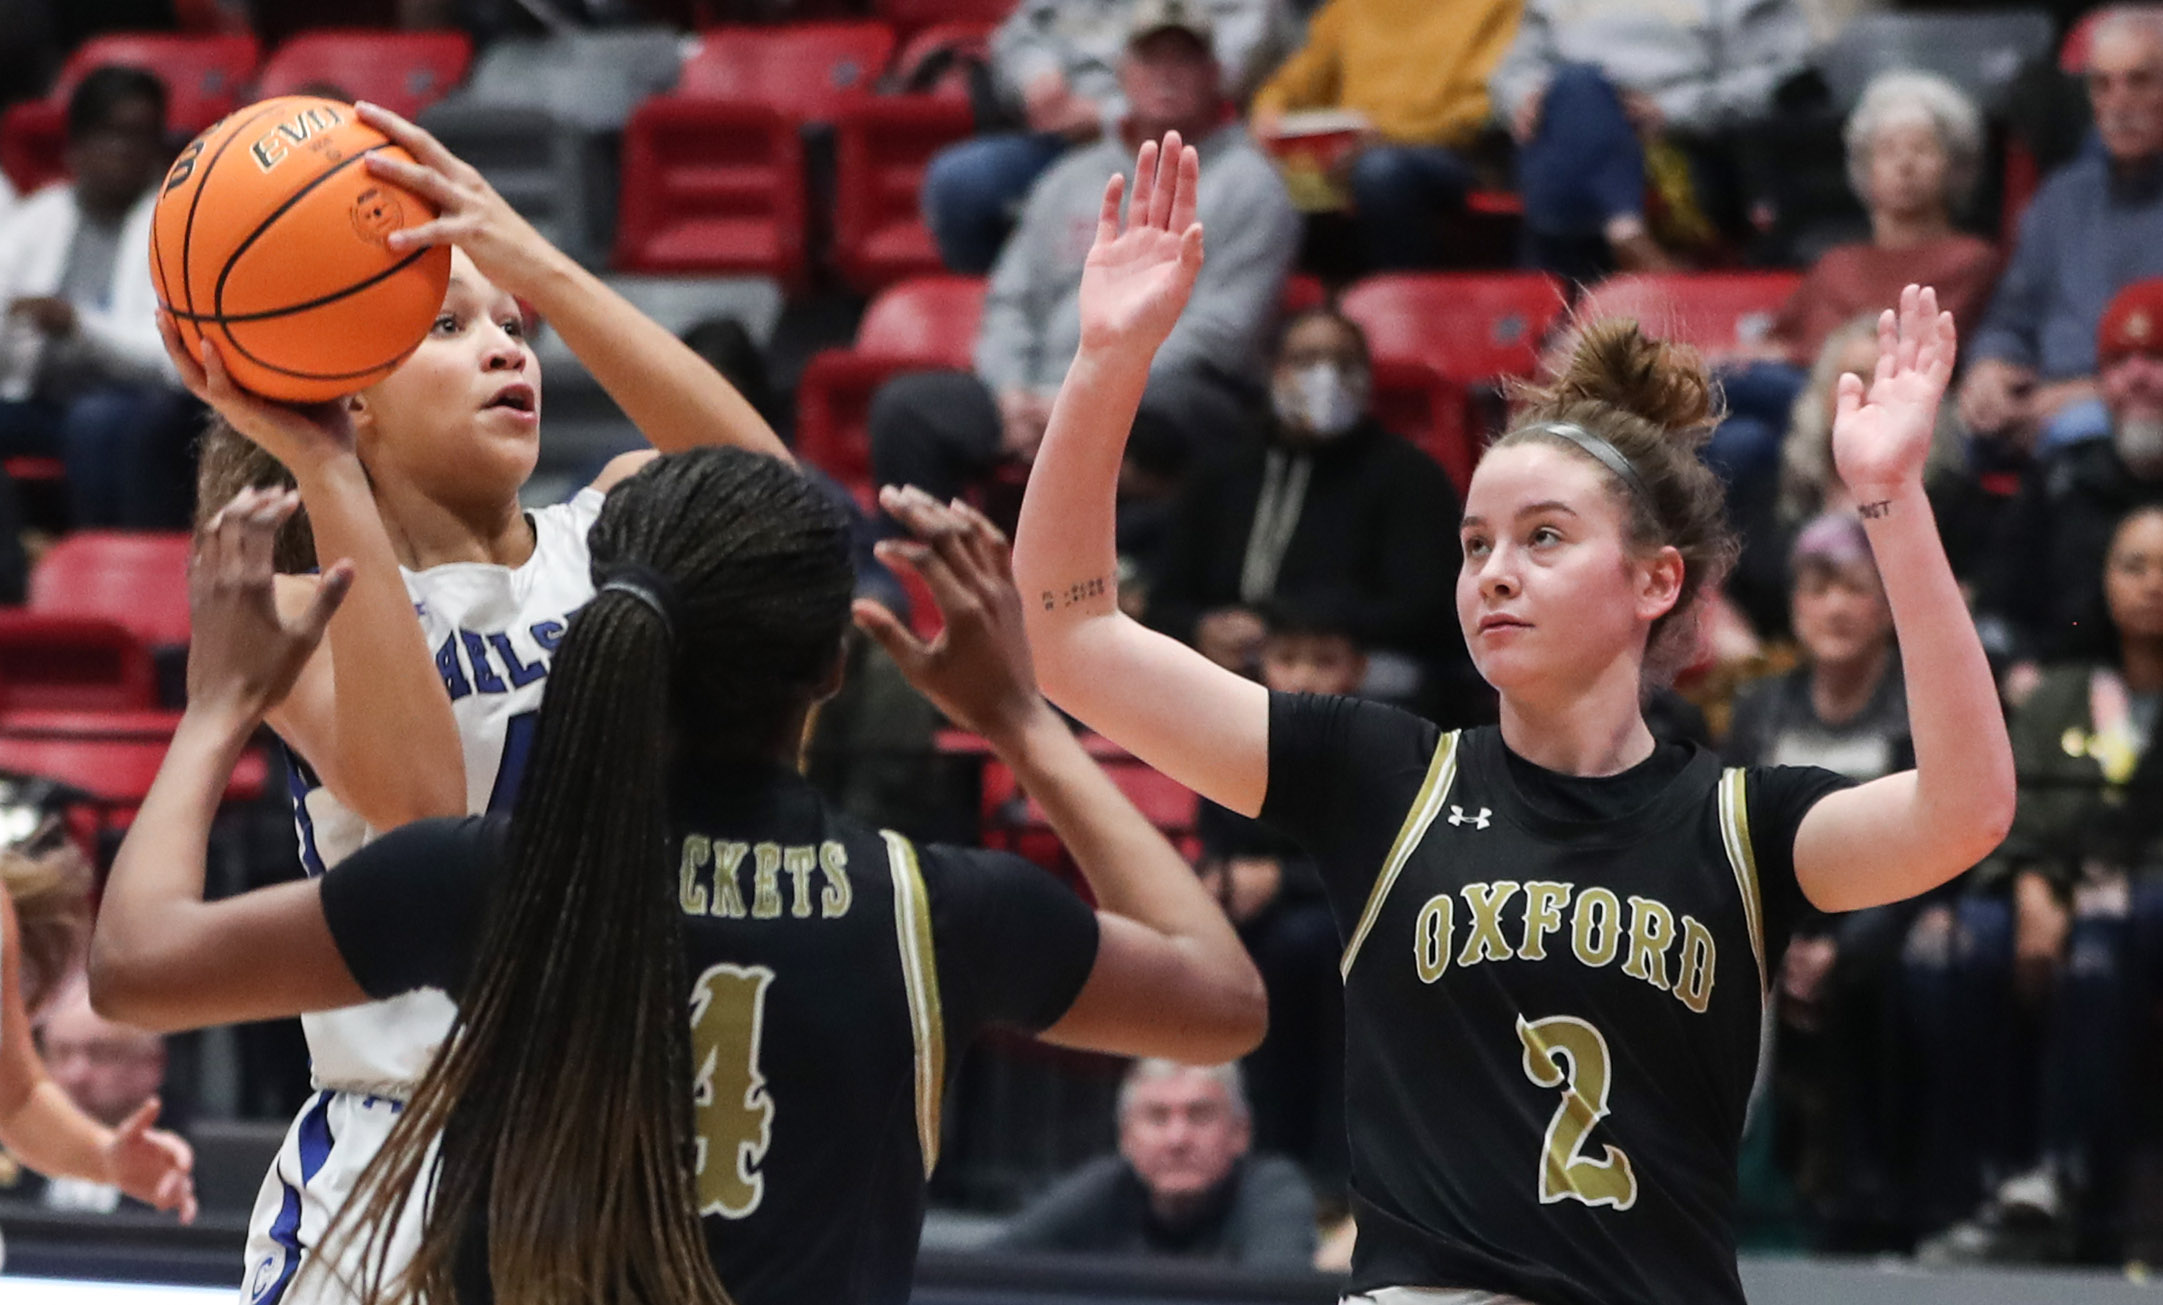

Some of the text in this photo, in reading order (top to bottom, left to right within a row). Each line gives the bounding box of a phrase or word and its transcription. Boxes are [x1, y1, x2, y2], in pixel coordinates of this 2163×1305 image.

[435, 606, 582, 702] HELS
[1413, 880, 1717, 1014] OXFORD
[1515, 1011, 1638, 1211] 2
